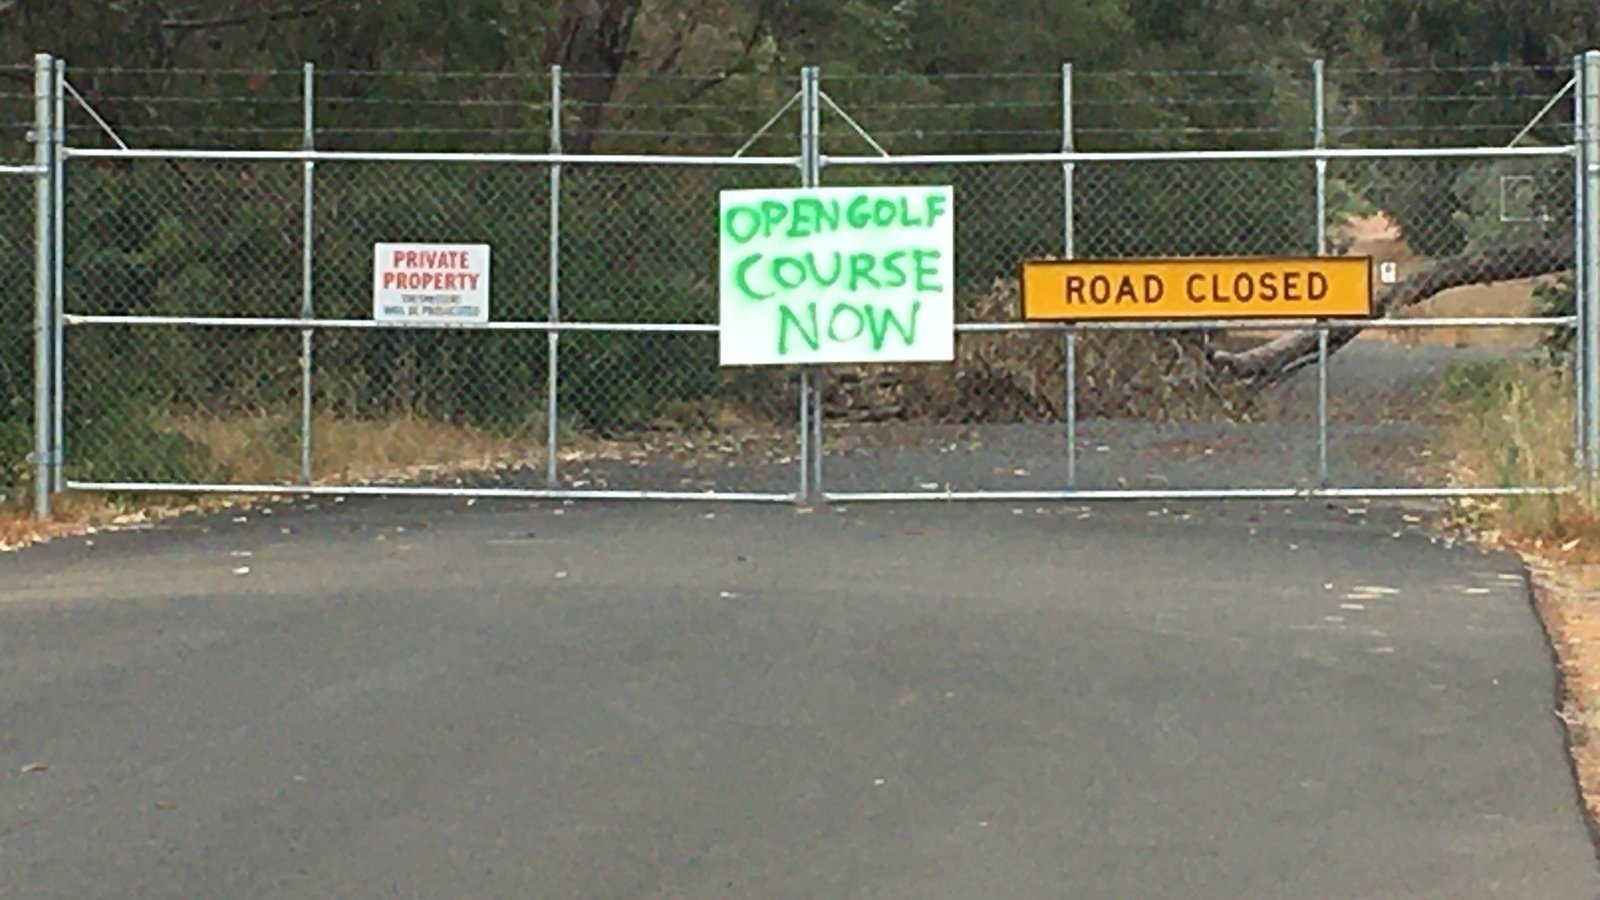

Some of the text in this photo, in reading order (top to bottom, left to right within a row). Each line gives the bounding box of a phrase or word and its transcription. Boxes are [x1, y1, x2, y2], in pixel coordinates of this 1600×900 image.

[726, 195, 946, 243] OPEN GOLF
[394, 250, 469, 269] PRIVATE
[736, 250, 944, 300] COURSE
[383, 272, 480, 290] PROPERTY
[1065, 271, 1329, 304] ROAD CLOSED
[778, 301, 920, 355] NOW
